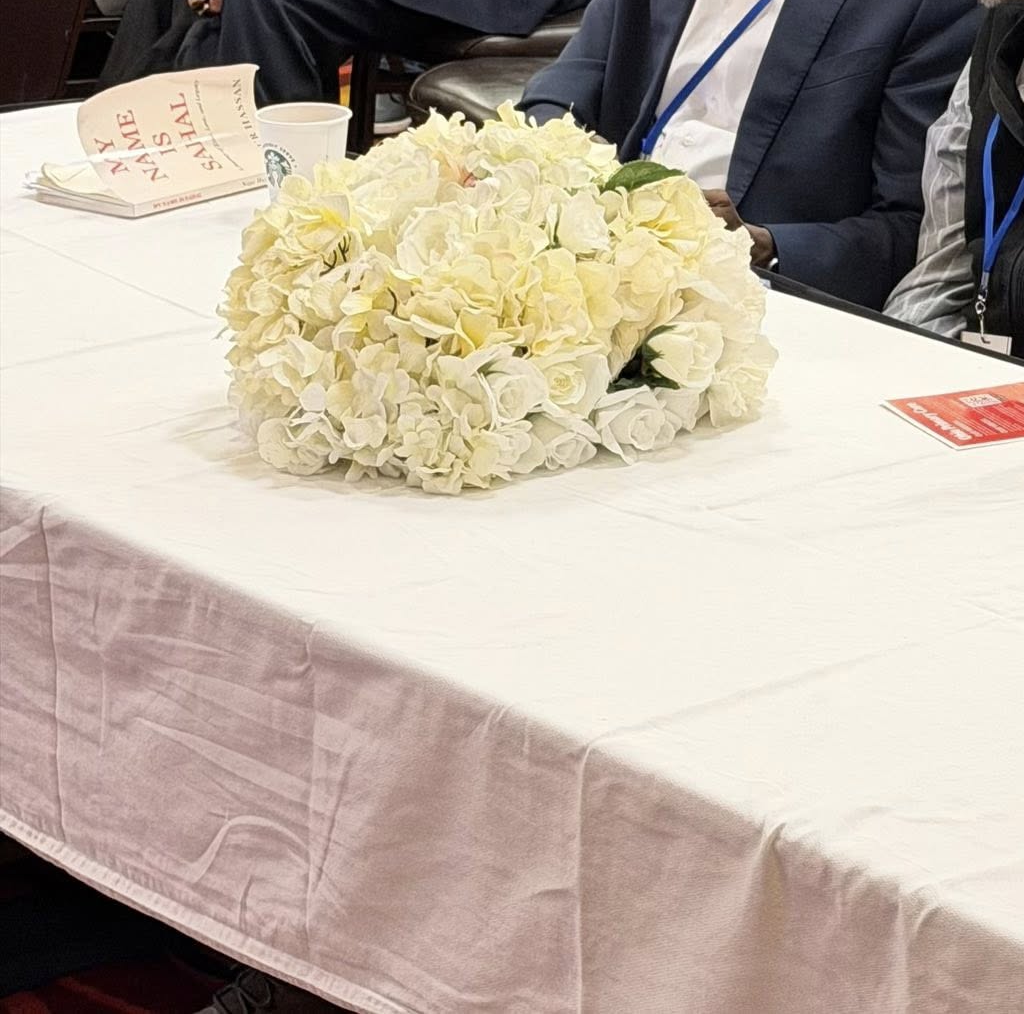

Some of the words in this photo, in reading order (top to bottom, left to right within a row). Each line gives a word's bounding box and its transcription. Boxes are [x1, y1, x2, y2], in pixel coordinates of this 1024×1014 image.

[93, 137, 130, 175] MY
[116, 109, 170, 182] NAME
[152, 132, 178, 156] IS
